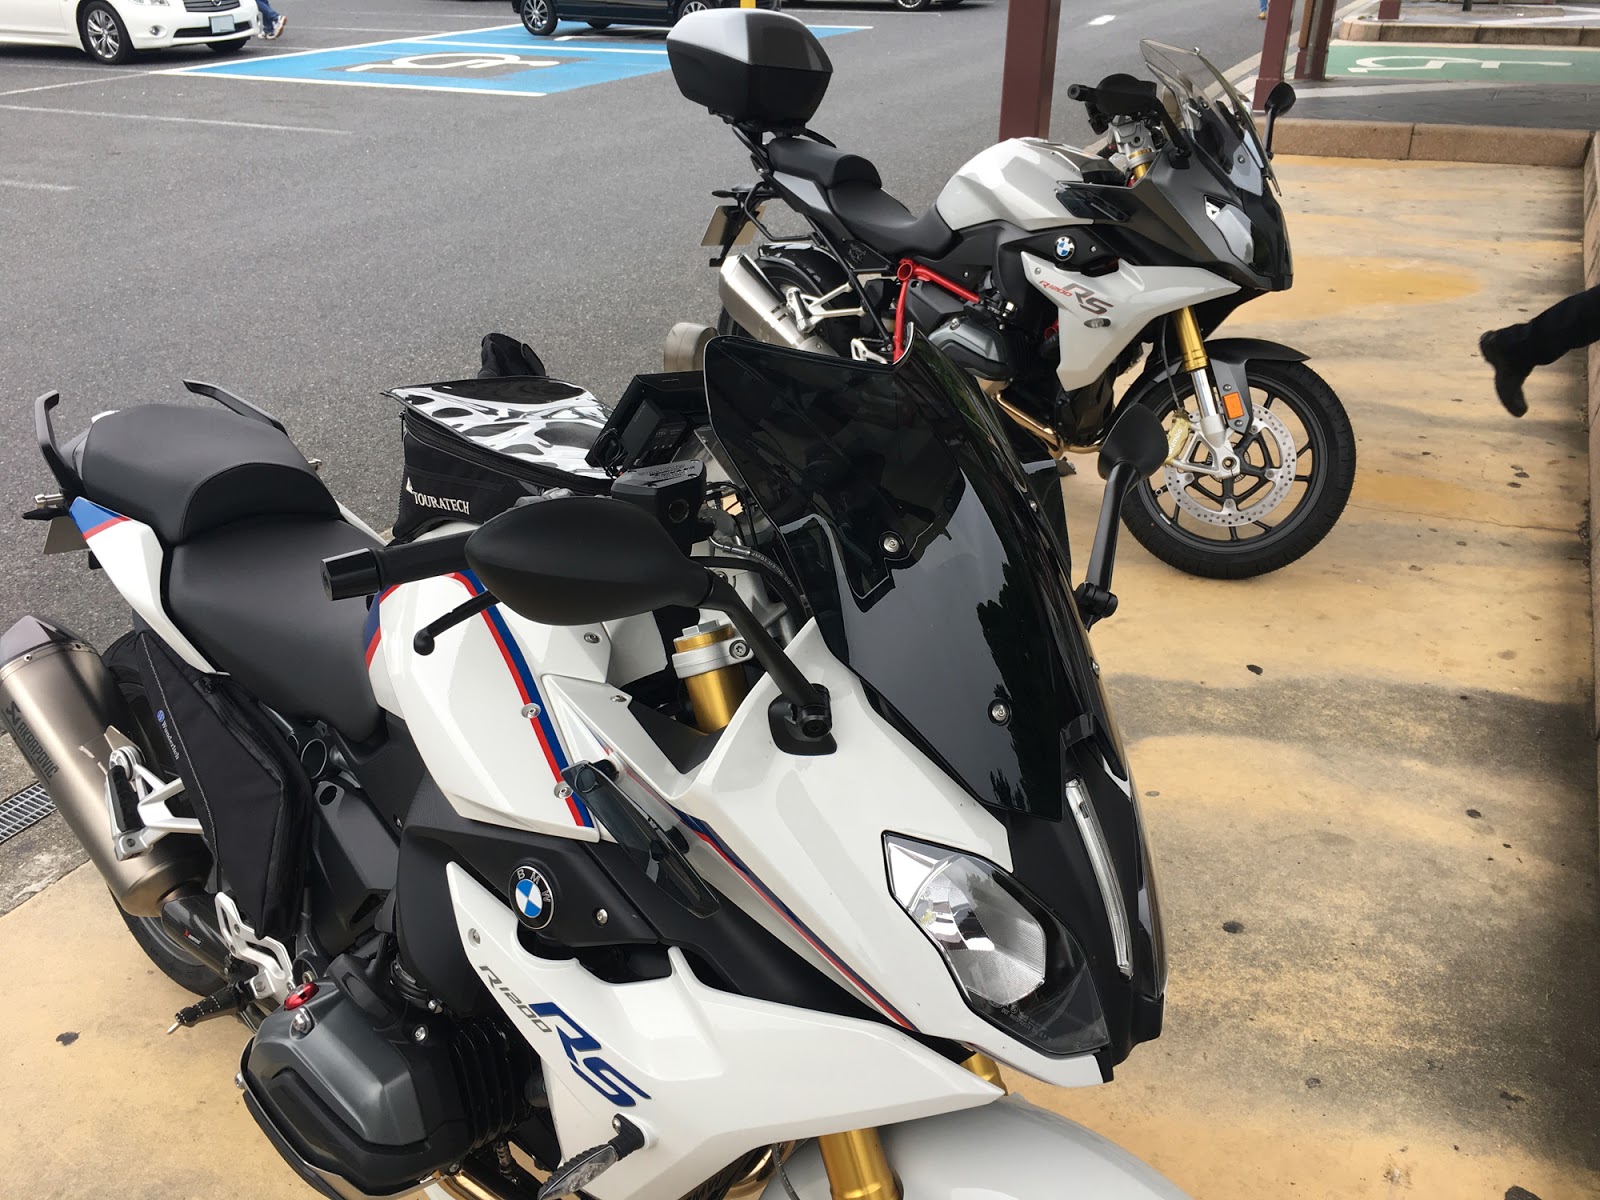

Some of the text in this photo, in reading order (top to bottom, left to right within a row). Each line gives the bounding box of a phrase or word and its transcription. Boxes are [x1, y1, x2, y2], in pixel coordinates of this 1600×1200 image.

[1039, 280, 1114, 315] R1200 RS
[413, 490, 470, 515] TOURATECH
[161, 720, 180, 760] Wunderlich
[479, 965, 652, 1108] R1200 RS
